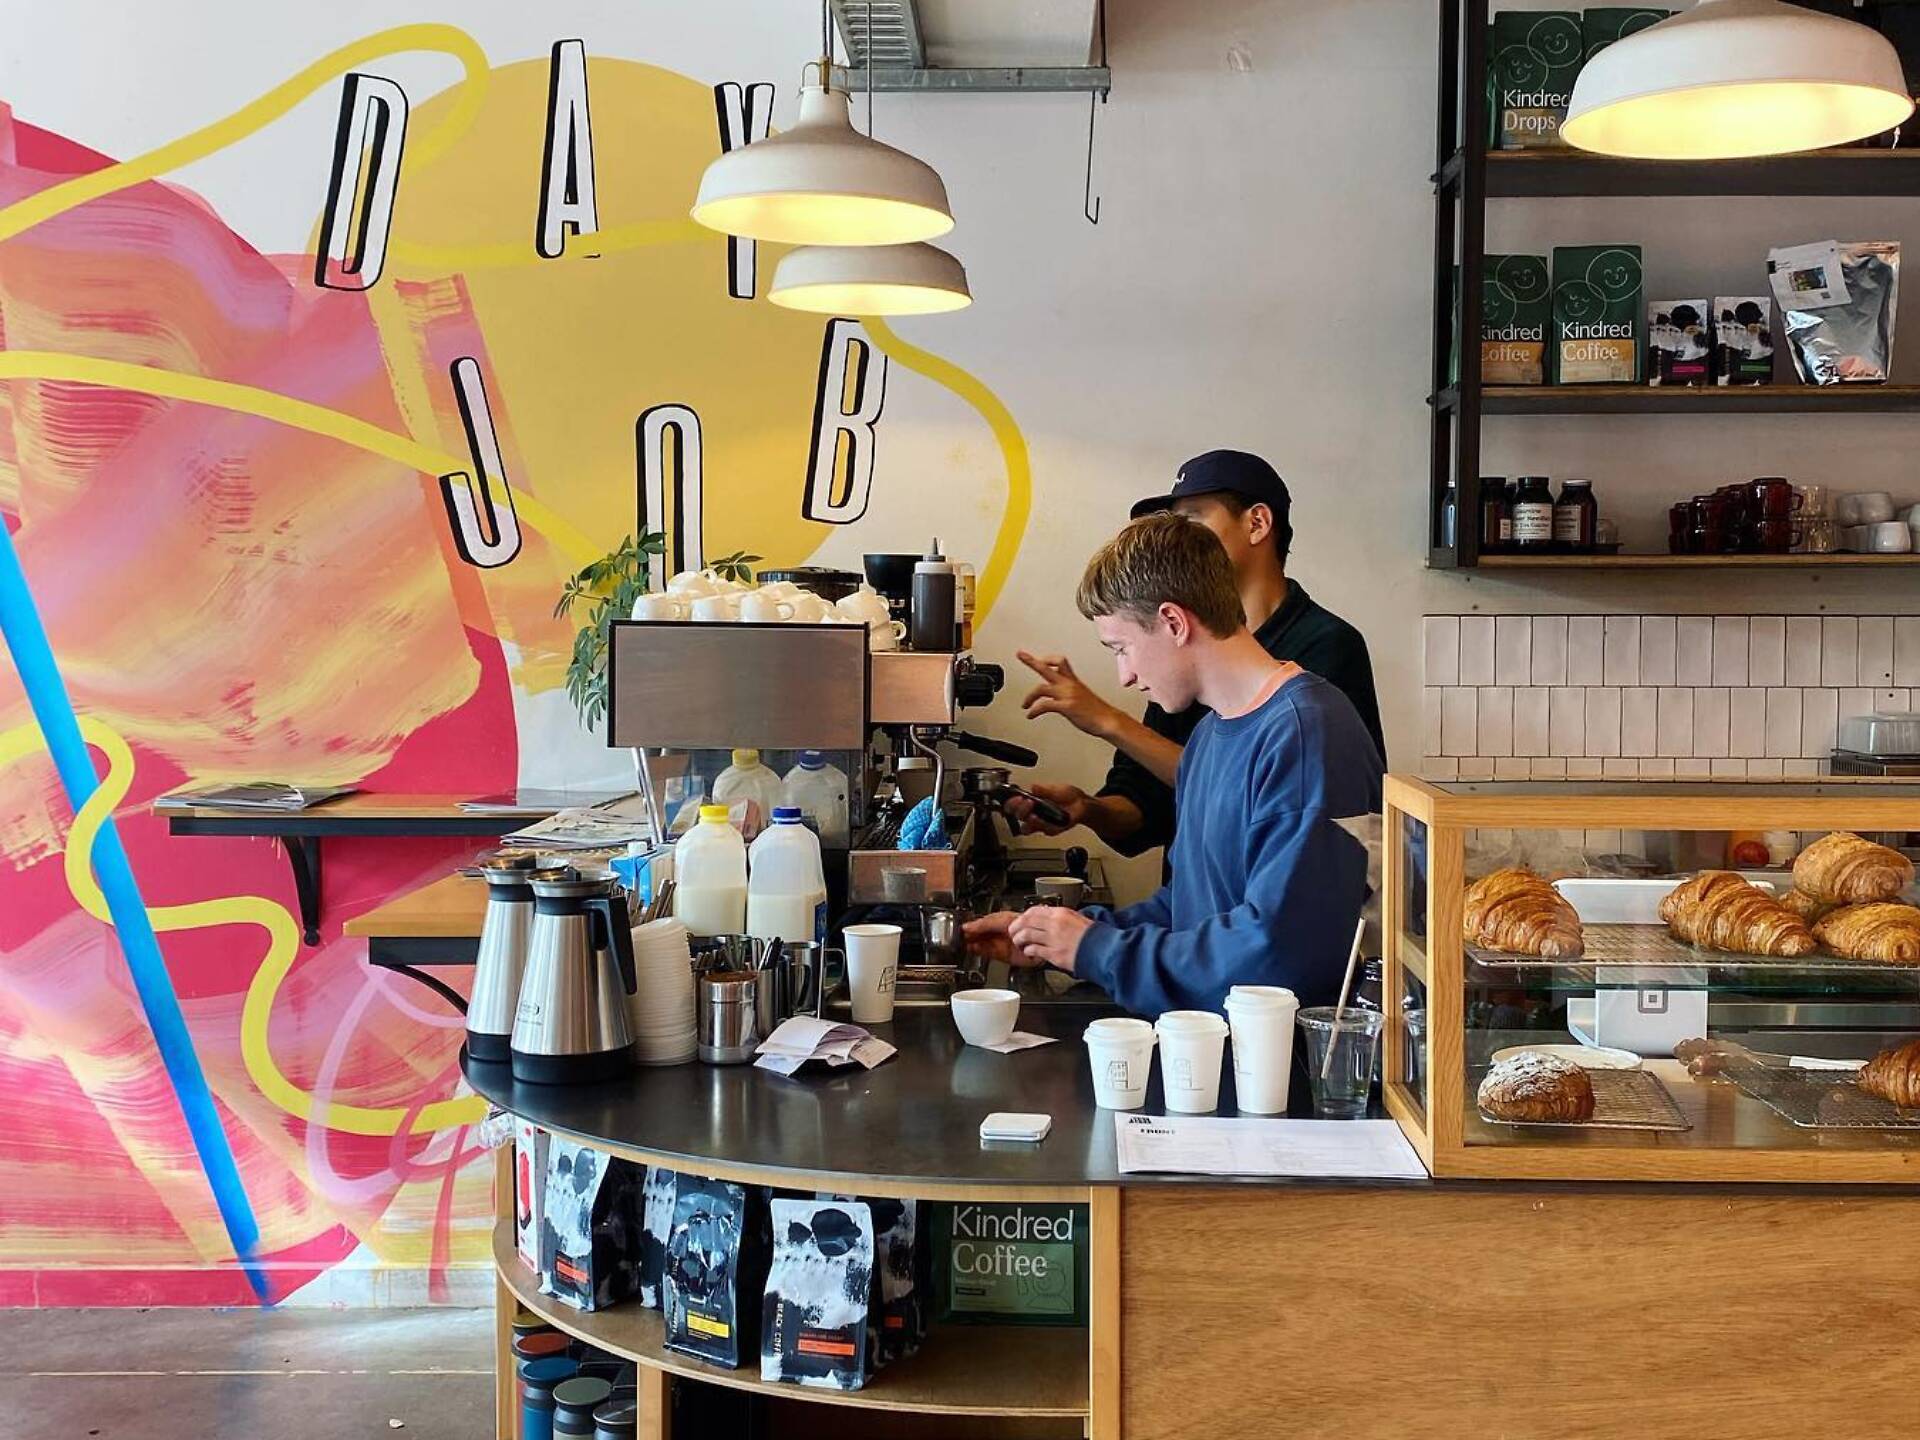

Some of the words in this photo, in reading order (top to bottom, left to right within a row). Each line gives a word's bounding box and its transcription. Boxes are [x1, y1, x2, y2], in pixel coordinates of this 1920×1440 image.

[1504, 111, 1556, 135] Drops
[1562, 320, 1632, 339] Kindred
[1563, 342, 1620, 362] Coffee
[952, 1205, 1074, 1240] Kindred
[952, 1243, 1049, 1277] Coffee
